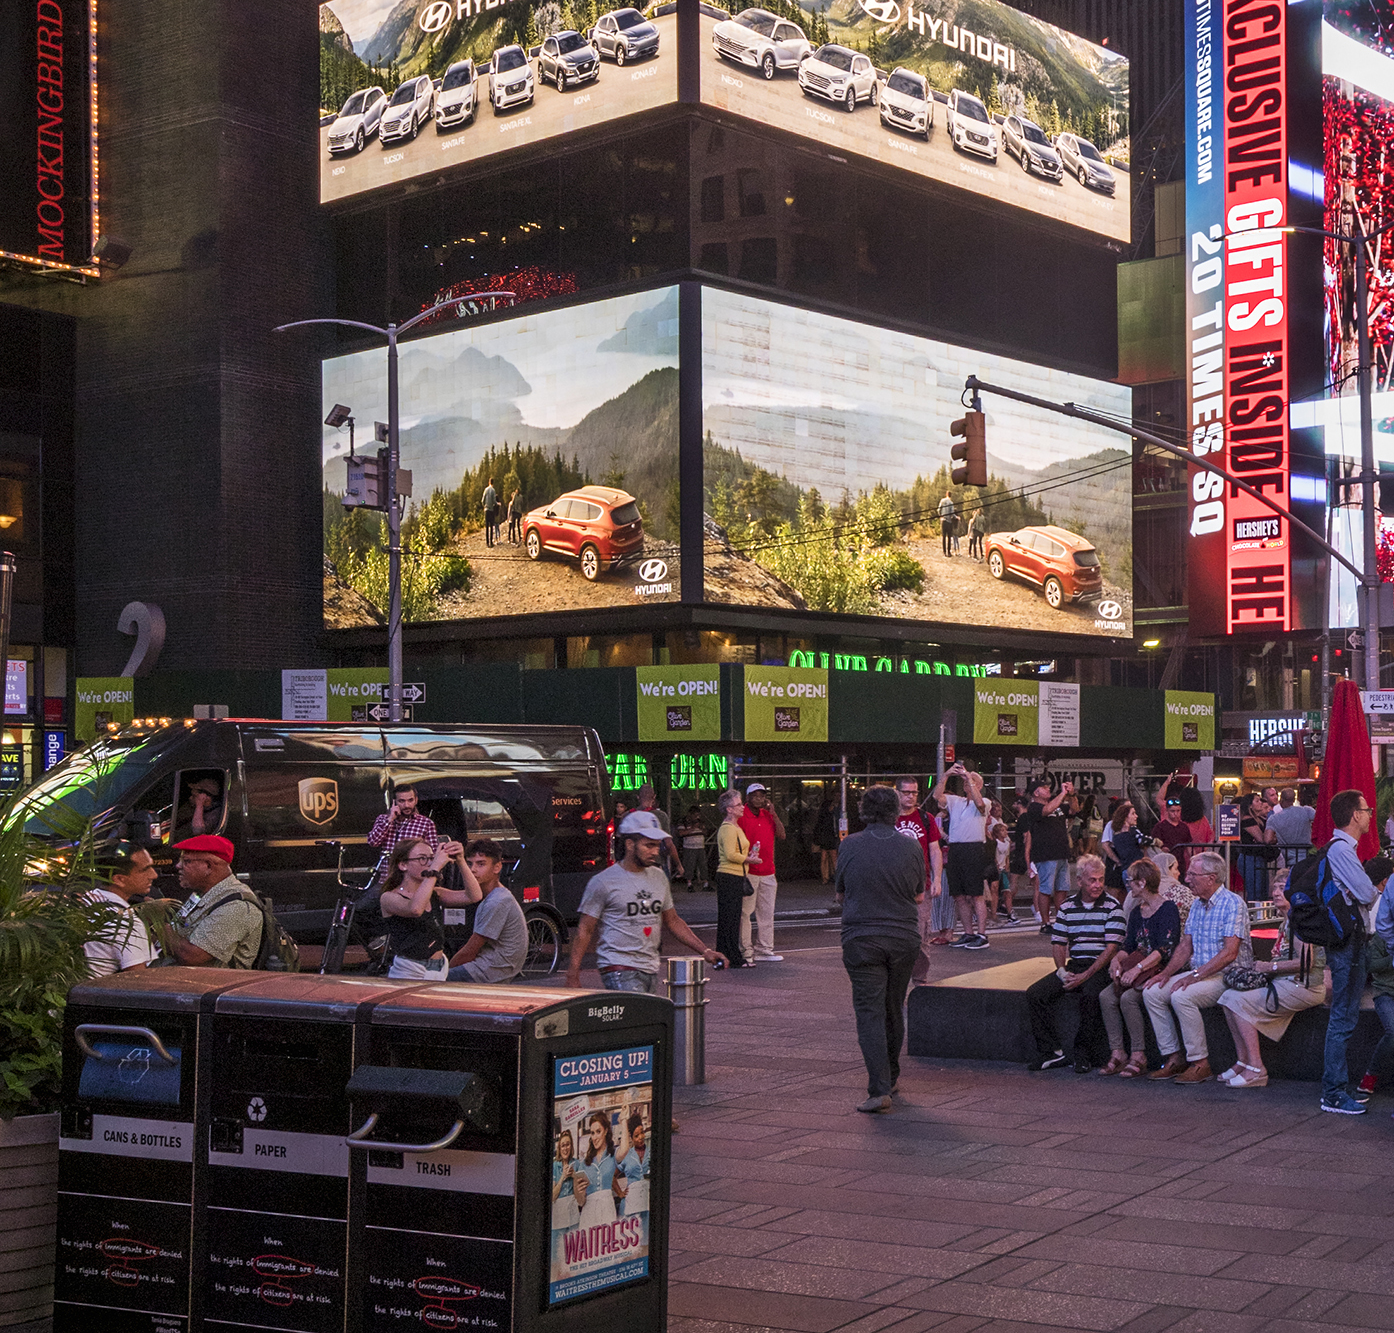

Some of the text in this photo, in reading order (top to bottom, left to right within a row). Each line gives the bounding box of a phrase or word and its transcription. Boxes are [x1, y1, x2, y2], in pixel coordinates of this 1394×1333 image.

[908, 6, 1016, 72] HYUNDAI
[721, 74, 744, 89] NEXO
[573, 93, 591, 106] KONA
[805, 107, 836, 125] TUCSON
[500, 121, 516, 133] SANTA
[441, 139, 457, 151] SANTA
[887, 138, 918, 156] SANTA FE
[383, 152, 404, 165] TUCSON
[332, 165, 346, 177] NEXO
[1227, 197, 1284, 332] GIFTS
[1190, 223, 1225, 538] 20 TIMES SQ
[1228, 339, 1285, 499] INSIDE
[1236, 520, 1279, 539] HERSHEY'S
[635, 583, 672, 595] HYUNDAI
[1094, 620, 1126, 630] HYUNDAI
[330, 682, 382, 697] We're OPE
[640, 680, 718, 697] We're OPEN!
[748, 682, 826, 698] We're OPEN!
[78, 690, 132, 704] We're OPEN!
[977, 691, 1038, 707] We're OPEN!
[668, 711, 683, 720] Olive
[1167, 702, 1214, 716] We're OPEN!
[669, 719, 691, 728] Garden
[776, 712, 790, 722] Olive
[777, 719, 799, 729] Garden
[303, 791, 336, 818] ups
[627, 899, 662, 916] D&G
[588, 1005, 625, 1018] BigBelly
[560, 1051, 649, 1077] CLOSING UP!
[579, 1069, 629, 1086] JANUARY 5
[104, 1130, 182, 1148] CANS & BOTTLES
[255, 1143, 287, 1158] PAPER
[416, 1161, 451, 1176] TRASH
[563, 1215, 640, 1265] WAITRESS
[554, 1266, 644, 1299] WAITRESSTHEMUSICAL.COM
